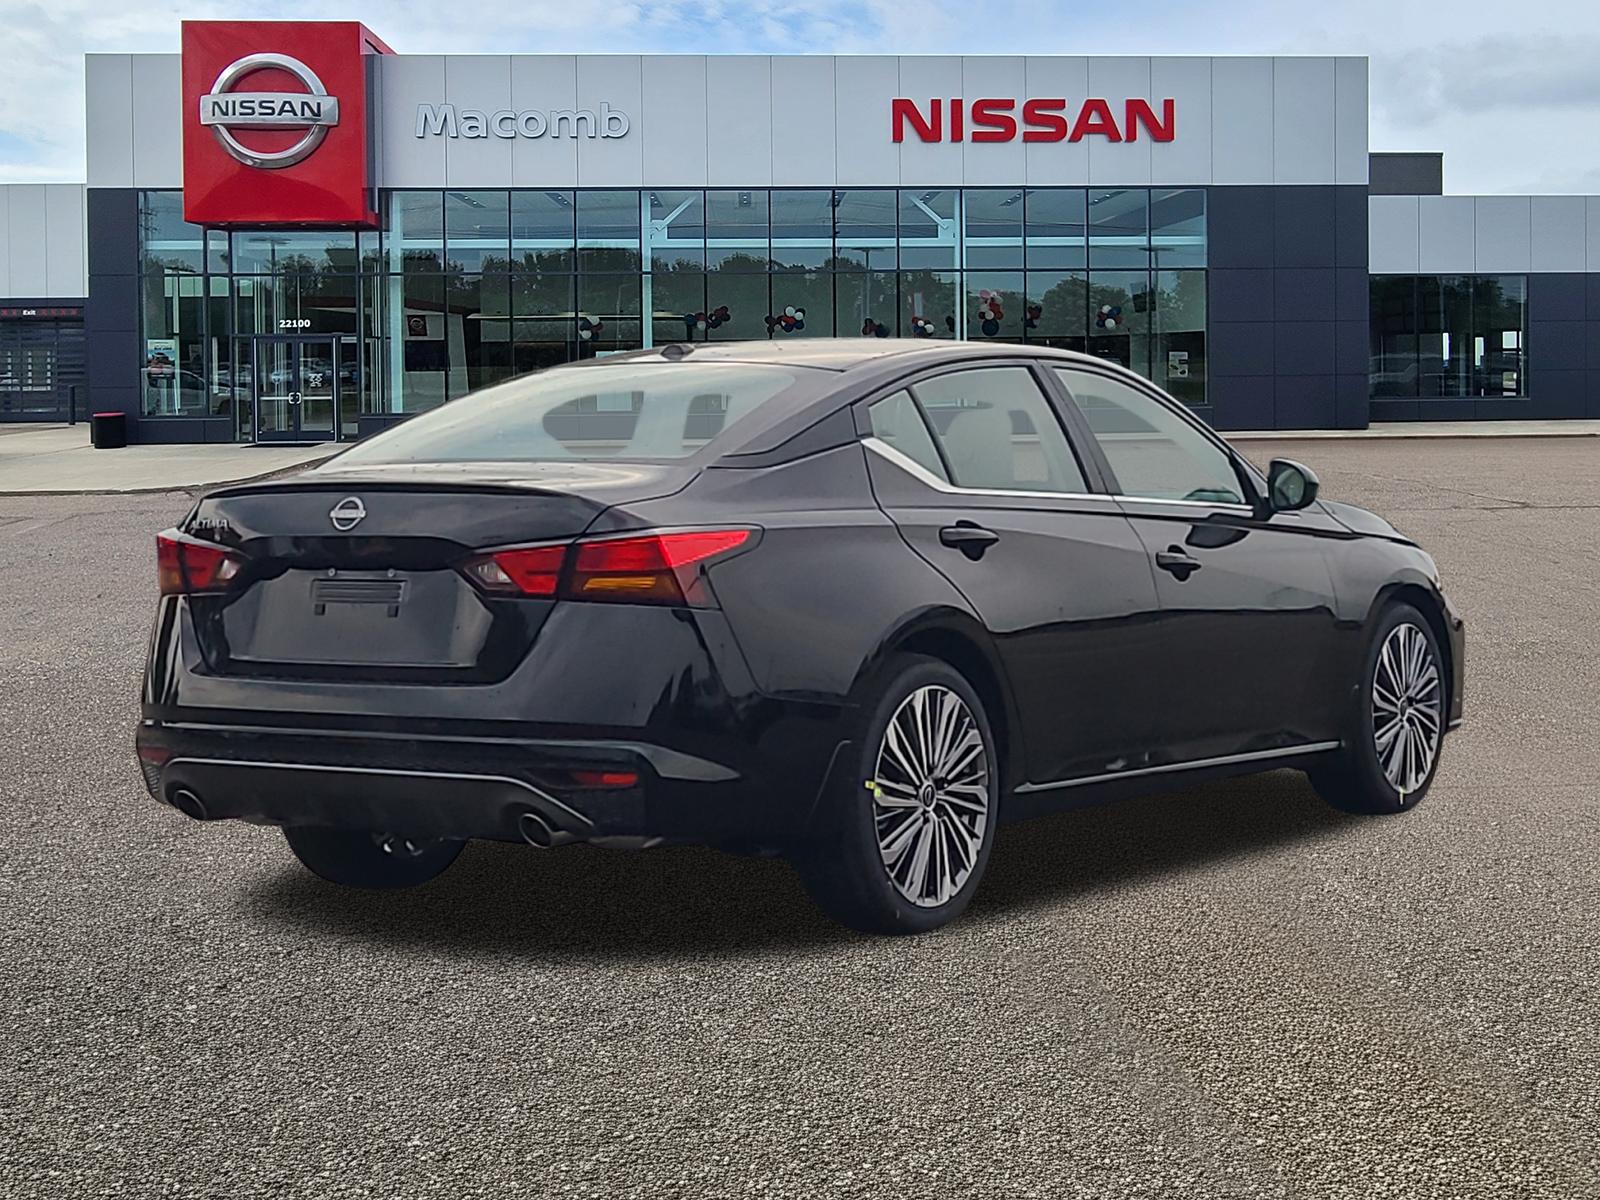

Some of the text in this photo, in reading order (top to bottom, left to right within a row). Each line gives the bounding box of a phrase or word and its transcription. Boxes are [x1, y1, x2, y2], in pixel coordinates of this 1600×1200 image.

[211, 100, 322, 118] NISSAN
[415, 102, 631, 139] Macomb
[891, 98, 1176, 143] NISSAN
[279, 319, 311, 328] 22100
